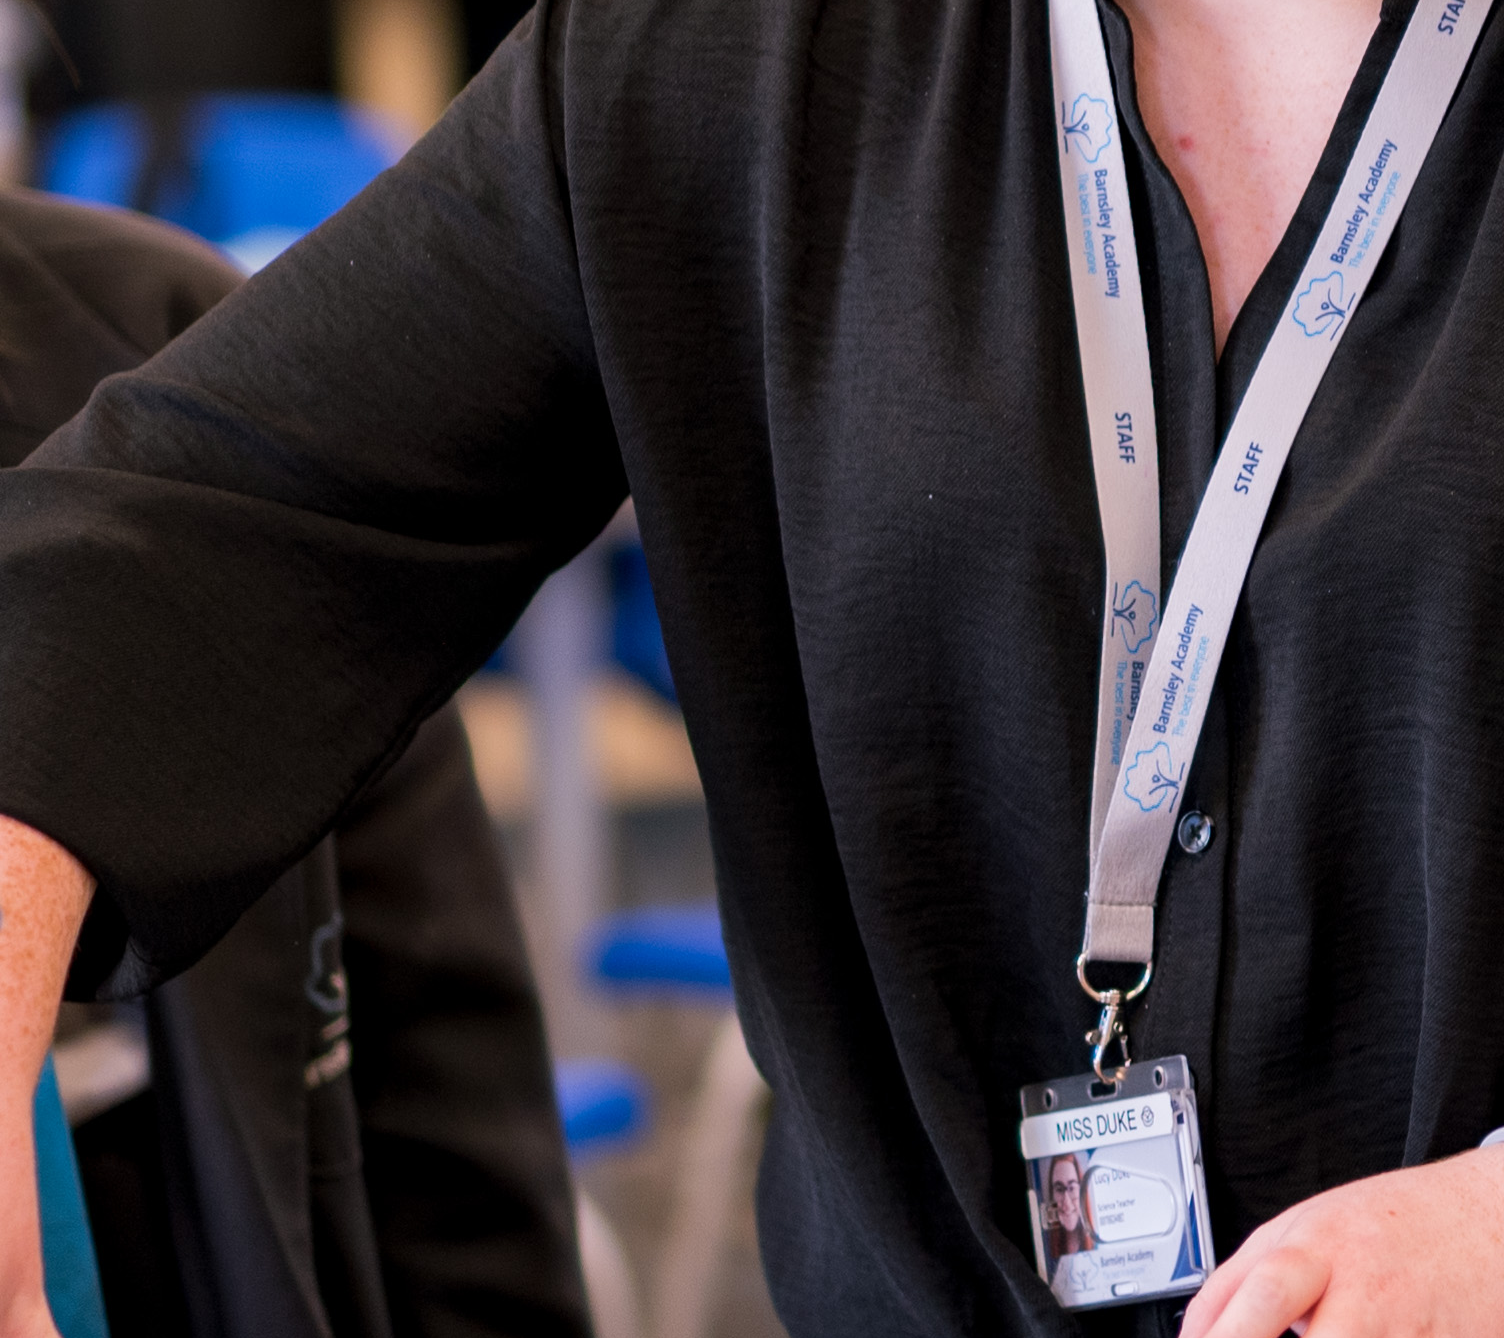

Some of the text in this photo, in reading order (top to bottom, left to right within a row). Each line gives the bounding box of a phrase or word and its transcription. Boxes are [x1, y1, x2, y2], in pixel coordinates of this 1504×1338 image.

[1077, 172, 1098, 276] The best in everyone
[1094, 168, 1121, 299] Barnsley Academy
[1329, 138, 1398, 264] Barnsley Academy
[1348, 169, 1402, 269] The best in everyone
[1114, 412, 1136, 465] STAFF
[1233, 441, 1264, 496] STAFF
[1152, 602, 1204, 735] Barnsley Academy
[1189, 634, 1210, 683] everyone
[1110, 660, 1128, 766] The best in everyone
[1171, 716, 1189, 737] The
[1178, 691, 1194, 717] best
[1056, 1108, 1138, 1144] MISS DUKE
